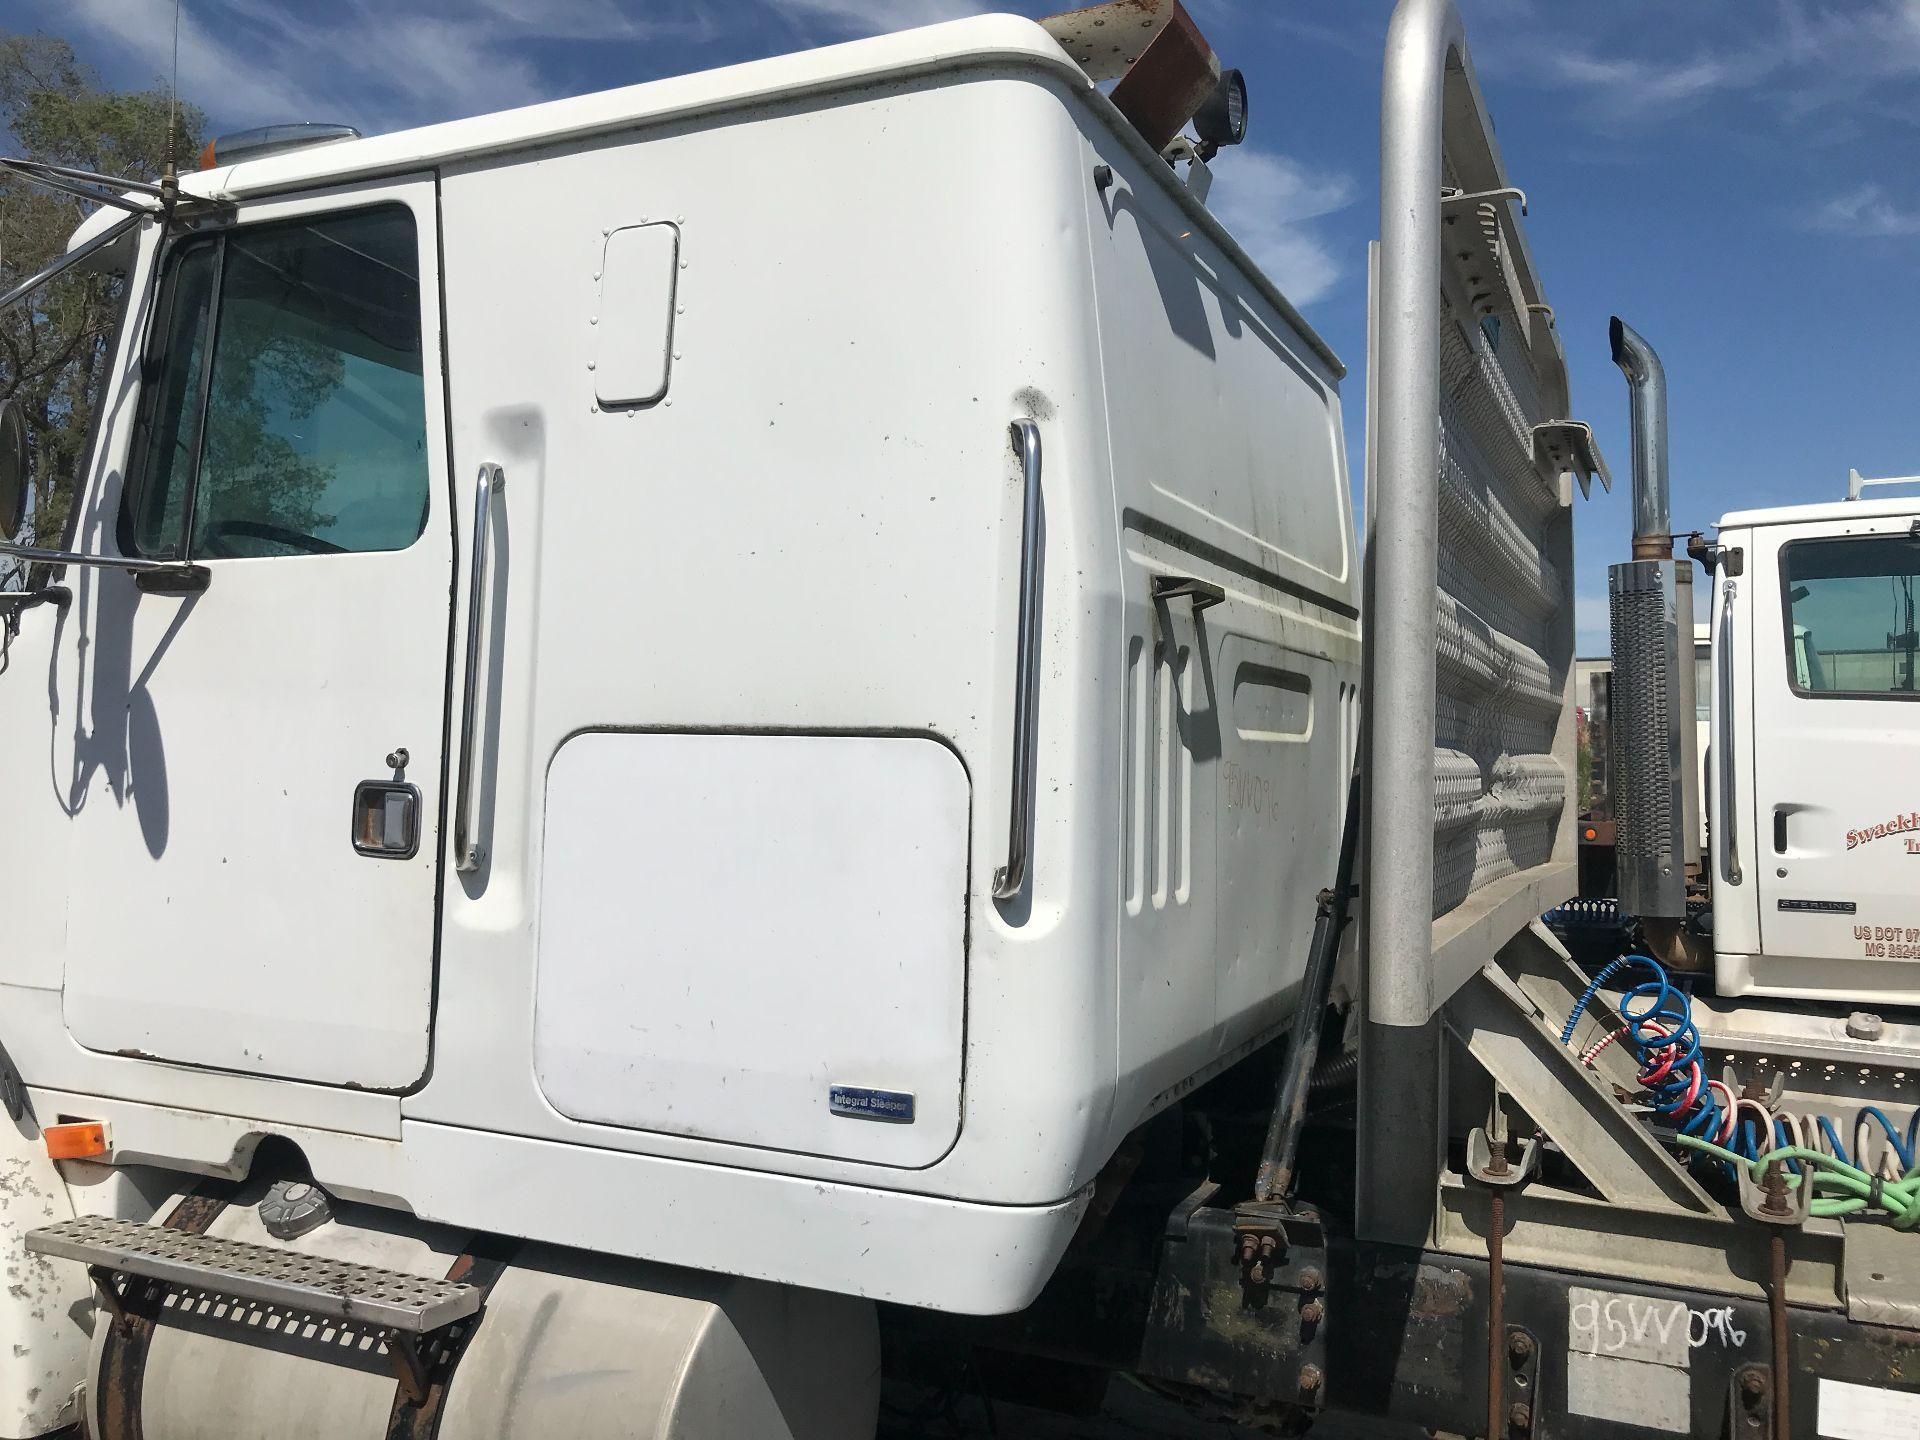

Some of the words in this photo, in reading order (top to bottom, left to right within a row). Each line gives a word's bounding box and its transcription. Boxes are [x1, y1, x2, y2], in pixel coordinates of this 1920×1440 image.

[1780, 900, 1854, 910] STERLING
[1853, 925, 1872, 940] US
[1874, 926, 1903, 942] DOT
[1865, 942, 1885, 957] MC
[834, 1093, 868, 1107] Integral
[870, 1098, 908, 1111] Sleeper
